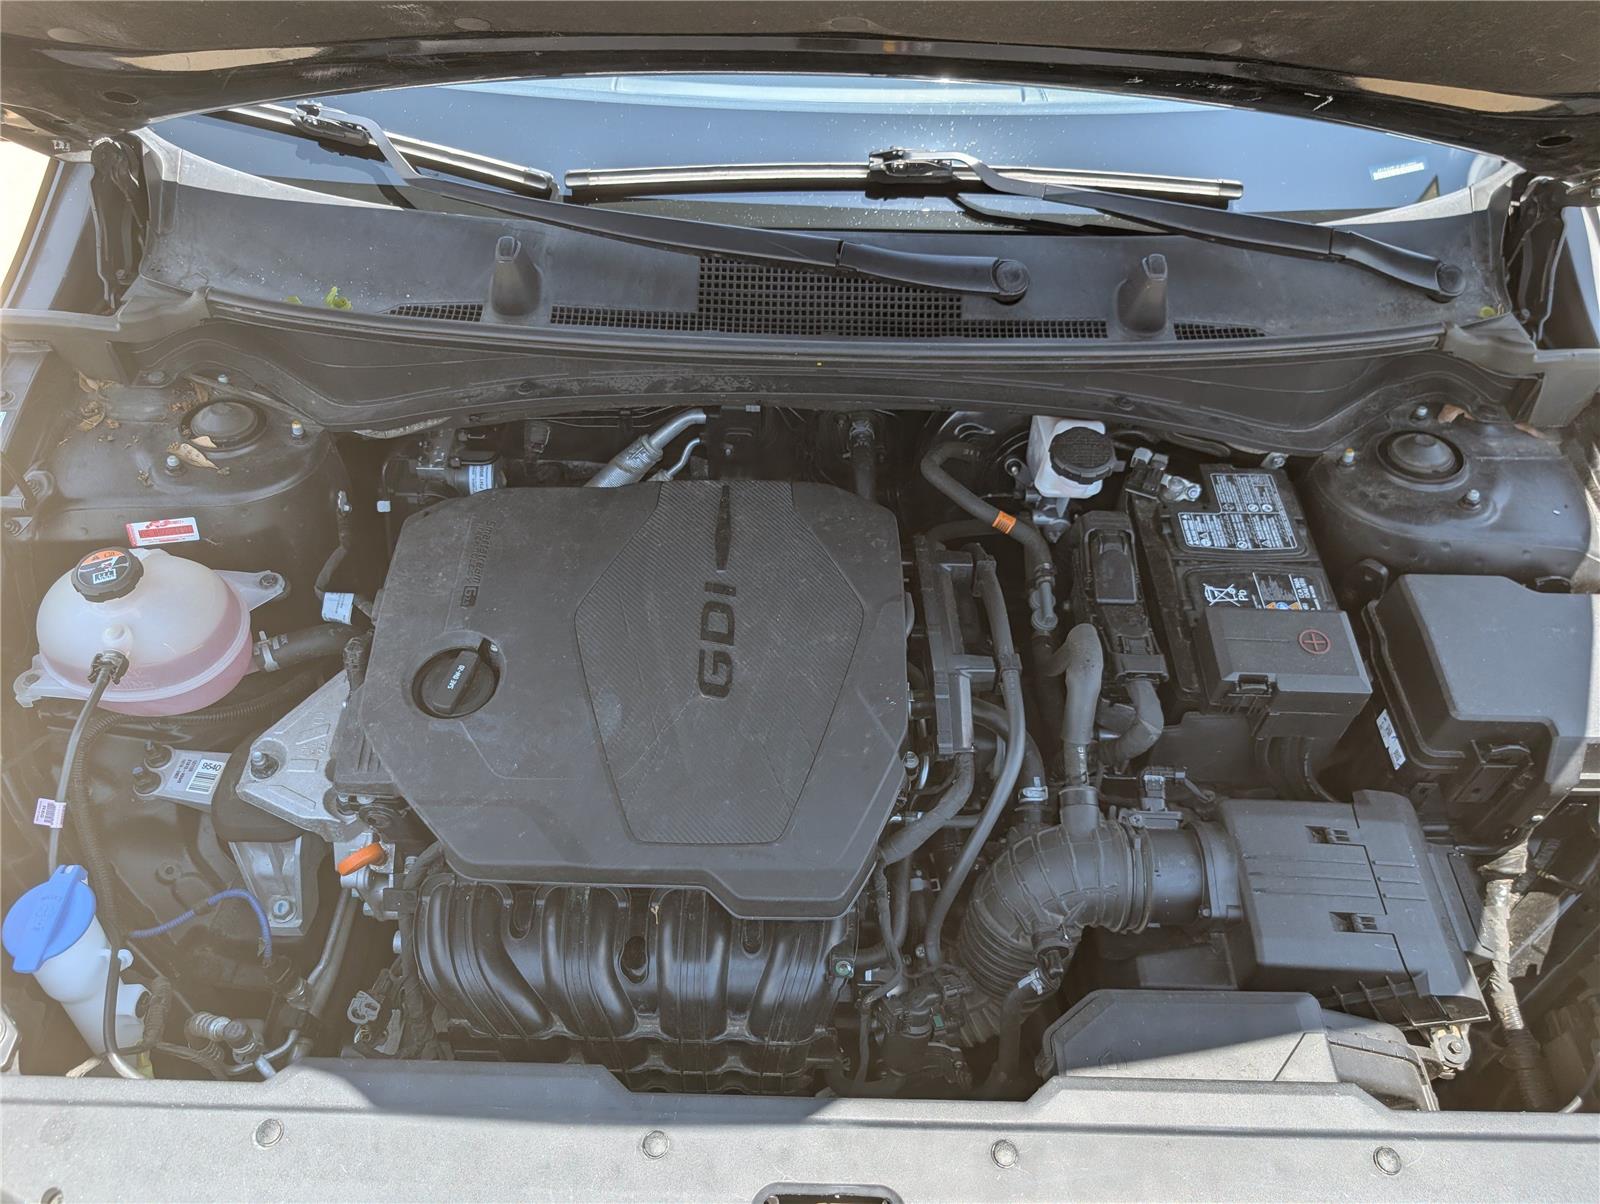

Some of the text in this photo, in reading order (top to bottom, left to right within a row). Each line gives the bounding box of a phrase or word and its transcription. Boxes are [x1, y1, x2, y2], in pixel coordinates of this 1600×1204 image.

[1237, 589, 1249, 601] Pb
[698, 581, 737, 698] GDI
[447, 679, 458, 690] SAE
[201, 762, 222, 772] 9540
